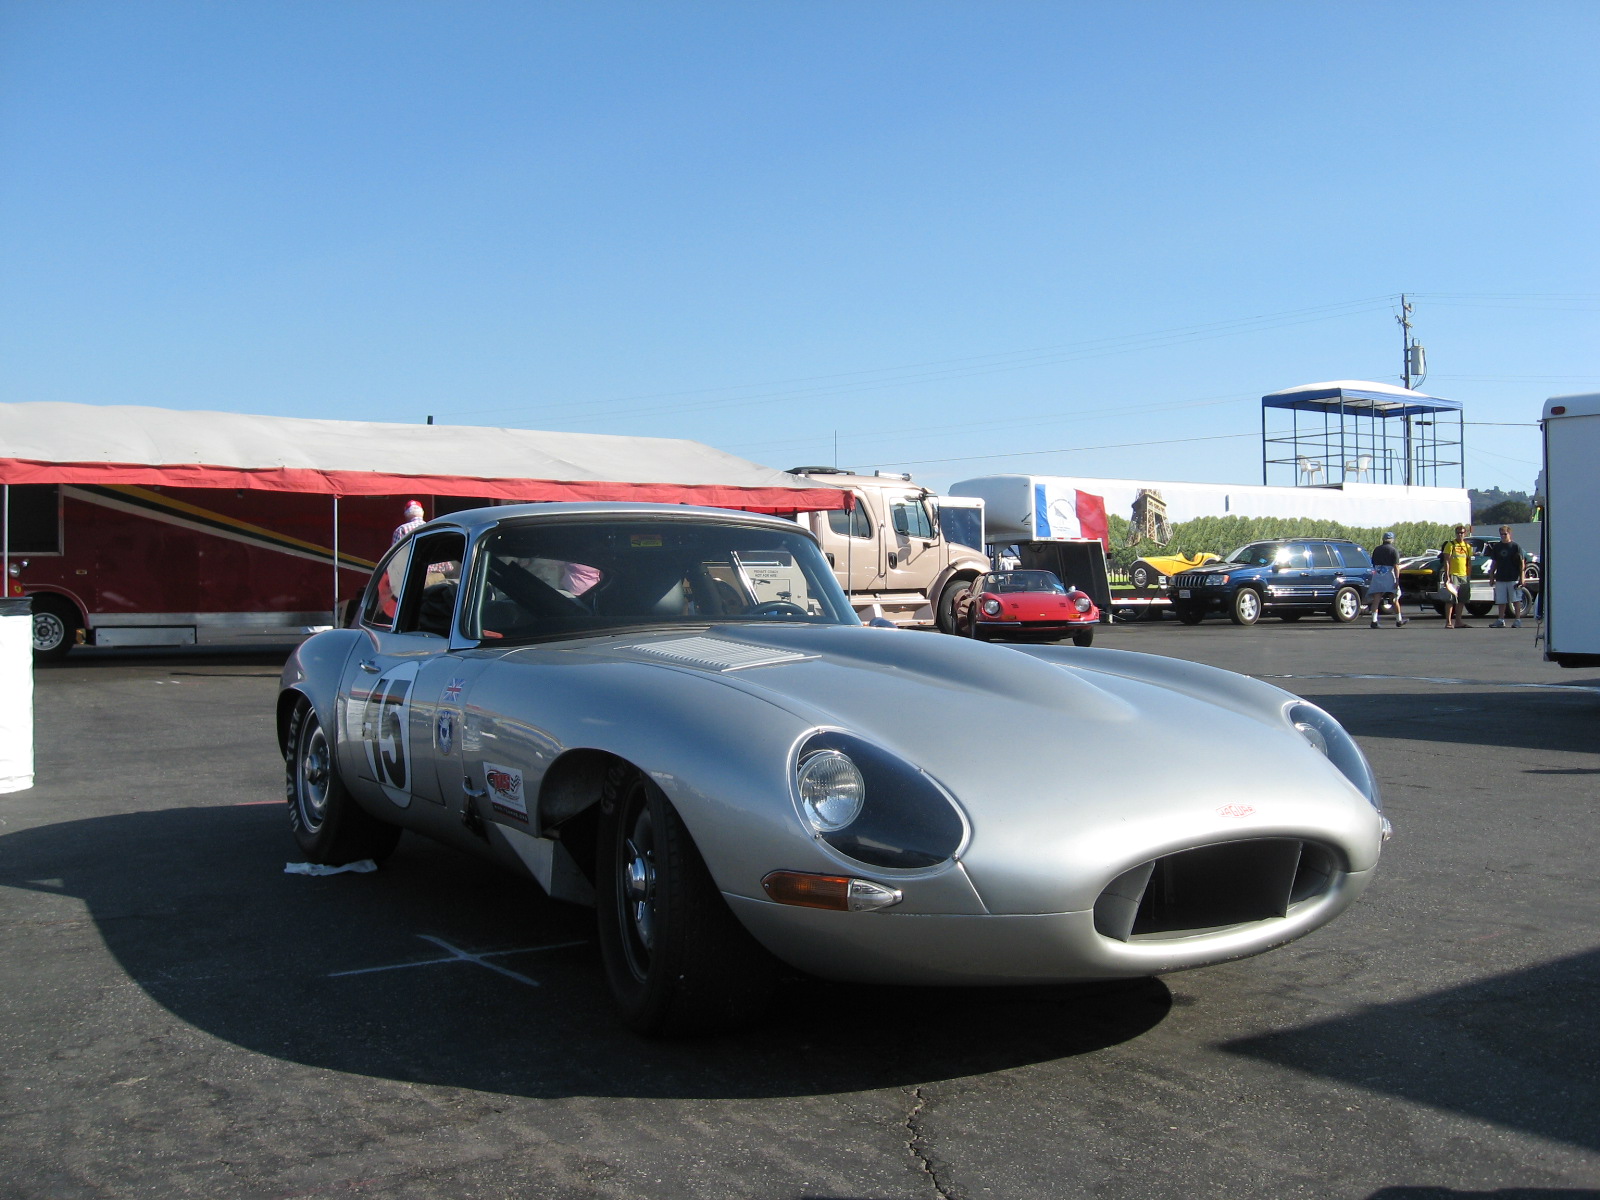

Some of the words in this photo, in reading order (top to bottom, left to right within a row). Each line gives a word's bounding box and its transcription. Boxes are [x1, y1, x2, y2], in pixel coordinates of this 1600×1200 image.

[286, 707, 302, 761] YEAR
[370, 678, 412, 789] 15
[1219, 804, 1254, 817] JAGUAR
